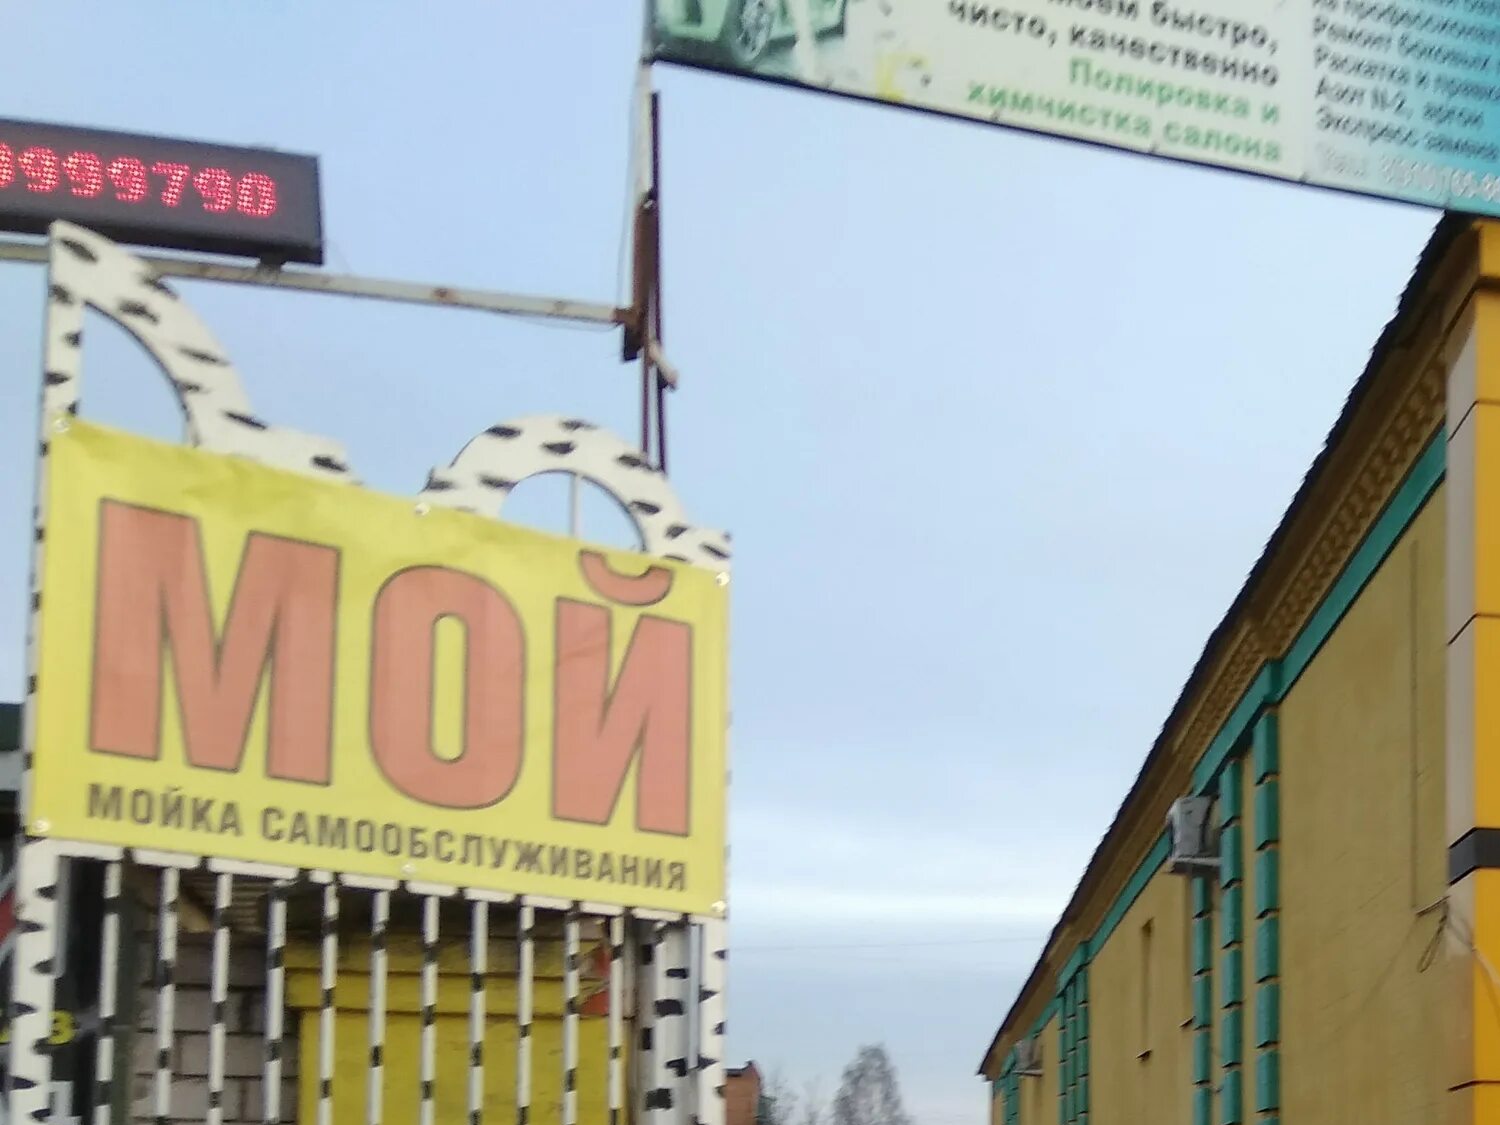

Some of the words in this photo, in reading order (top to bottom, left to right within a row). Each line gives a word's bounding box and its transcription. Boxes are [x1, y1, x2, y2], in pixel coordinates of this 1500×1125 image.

[1069, 24, 1279, 88] качественно
[1151, 1, 1278, 55] быстро,
[967, 82, 1152, 138] химчистка
[1163, 120, 1281, 162] салона
[1069, 57, 1250, 118] Полировка
[1260, 102, 1279, 124] и
[88, 496, 694, 837] МОЙ
[87, 781, 244, 838] МОЙКА
[260, 805, 689, 892] САМООБСЛУЖИВАНИЯ
